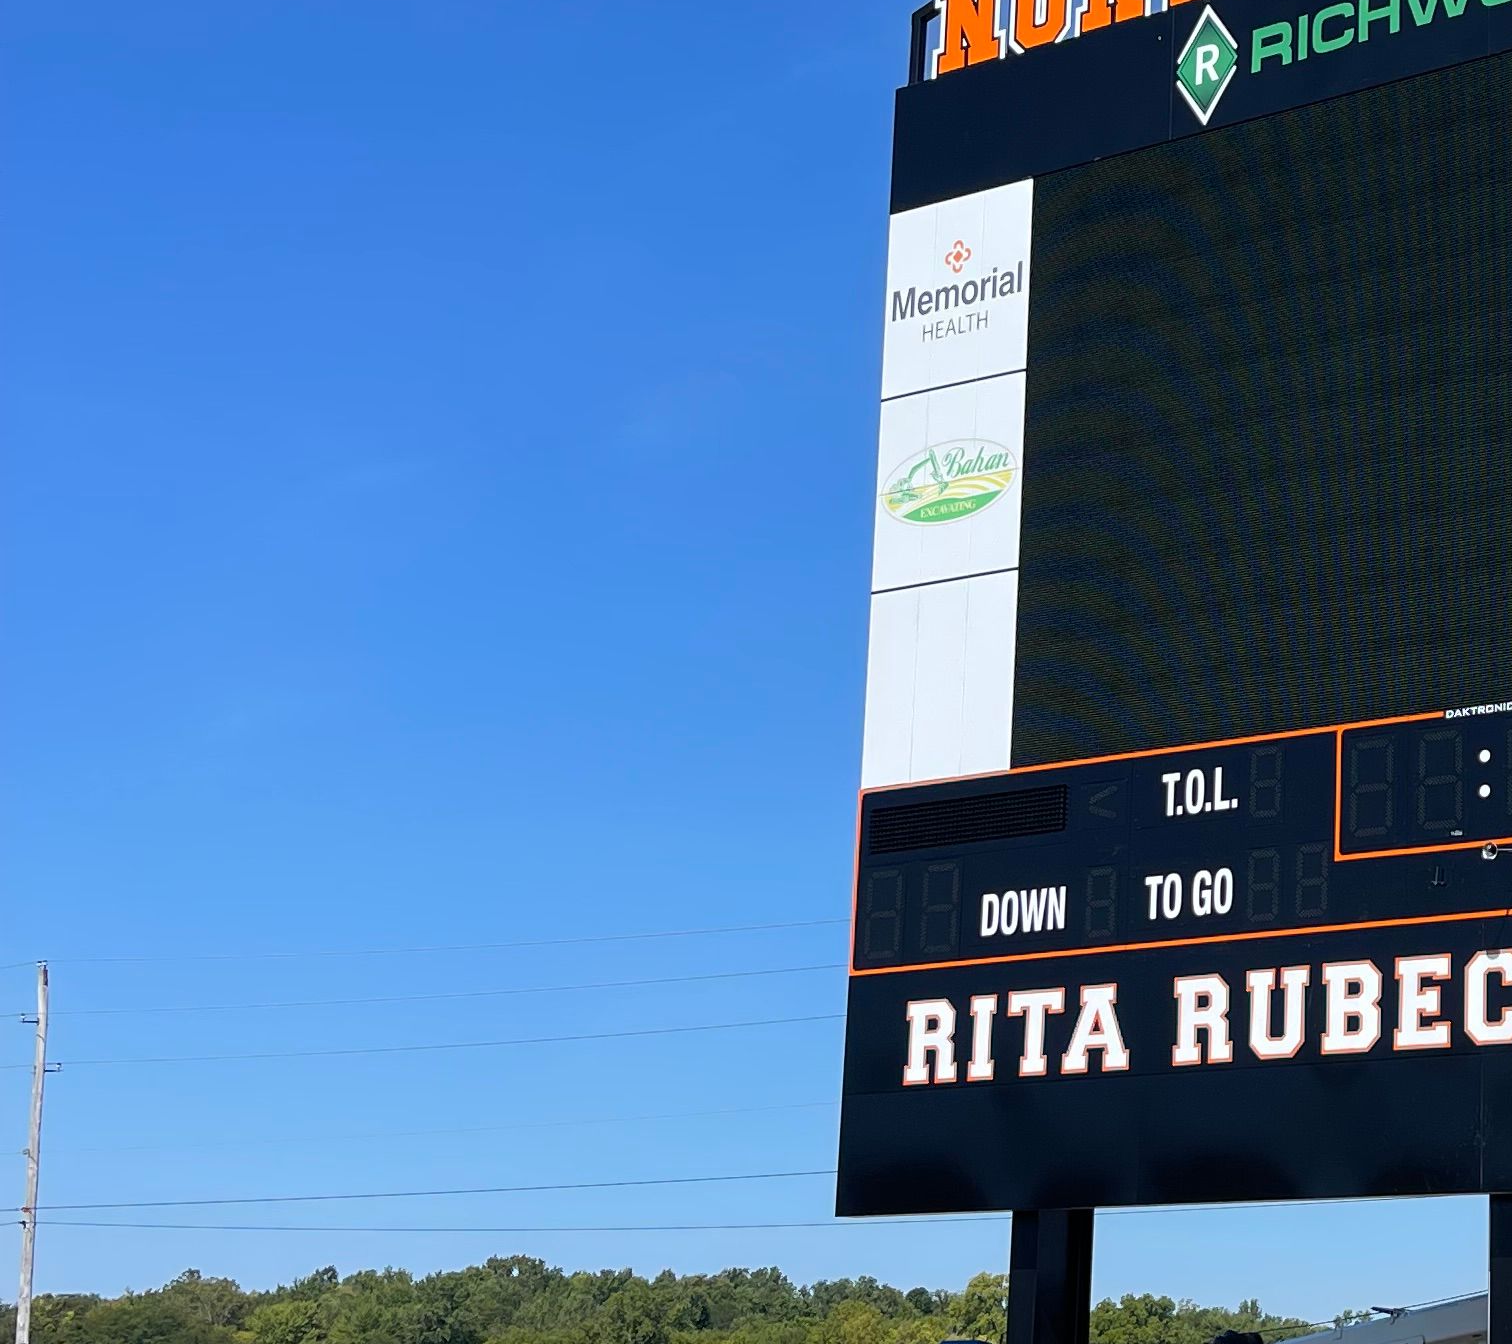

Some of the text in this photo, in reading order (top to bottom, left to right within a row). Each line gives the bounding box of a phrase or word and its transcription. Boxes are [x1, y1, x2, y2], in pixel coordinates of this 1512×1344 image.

[1195, 42, 1221, 87] R
[892, 260, 1023, 322] Memorial
[922, 310, 989, 342] HEALTH
[920, 499, 977, 518] EXCAVATING
[1162, 766, 1239, 817] T.O.L.
[980, 885, 1068, 938] DOWN
[1144, 867, 1234, 920] TO GO
[902, 982, 1131, 1086] RITA
